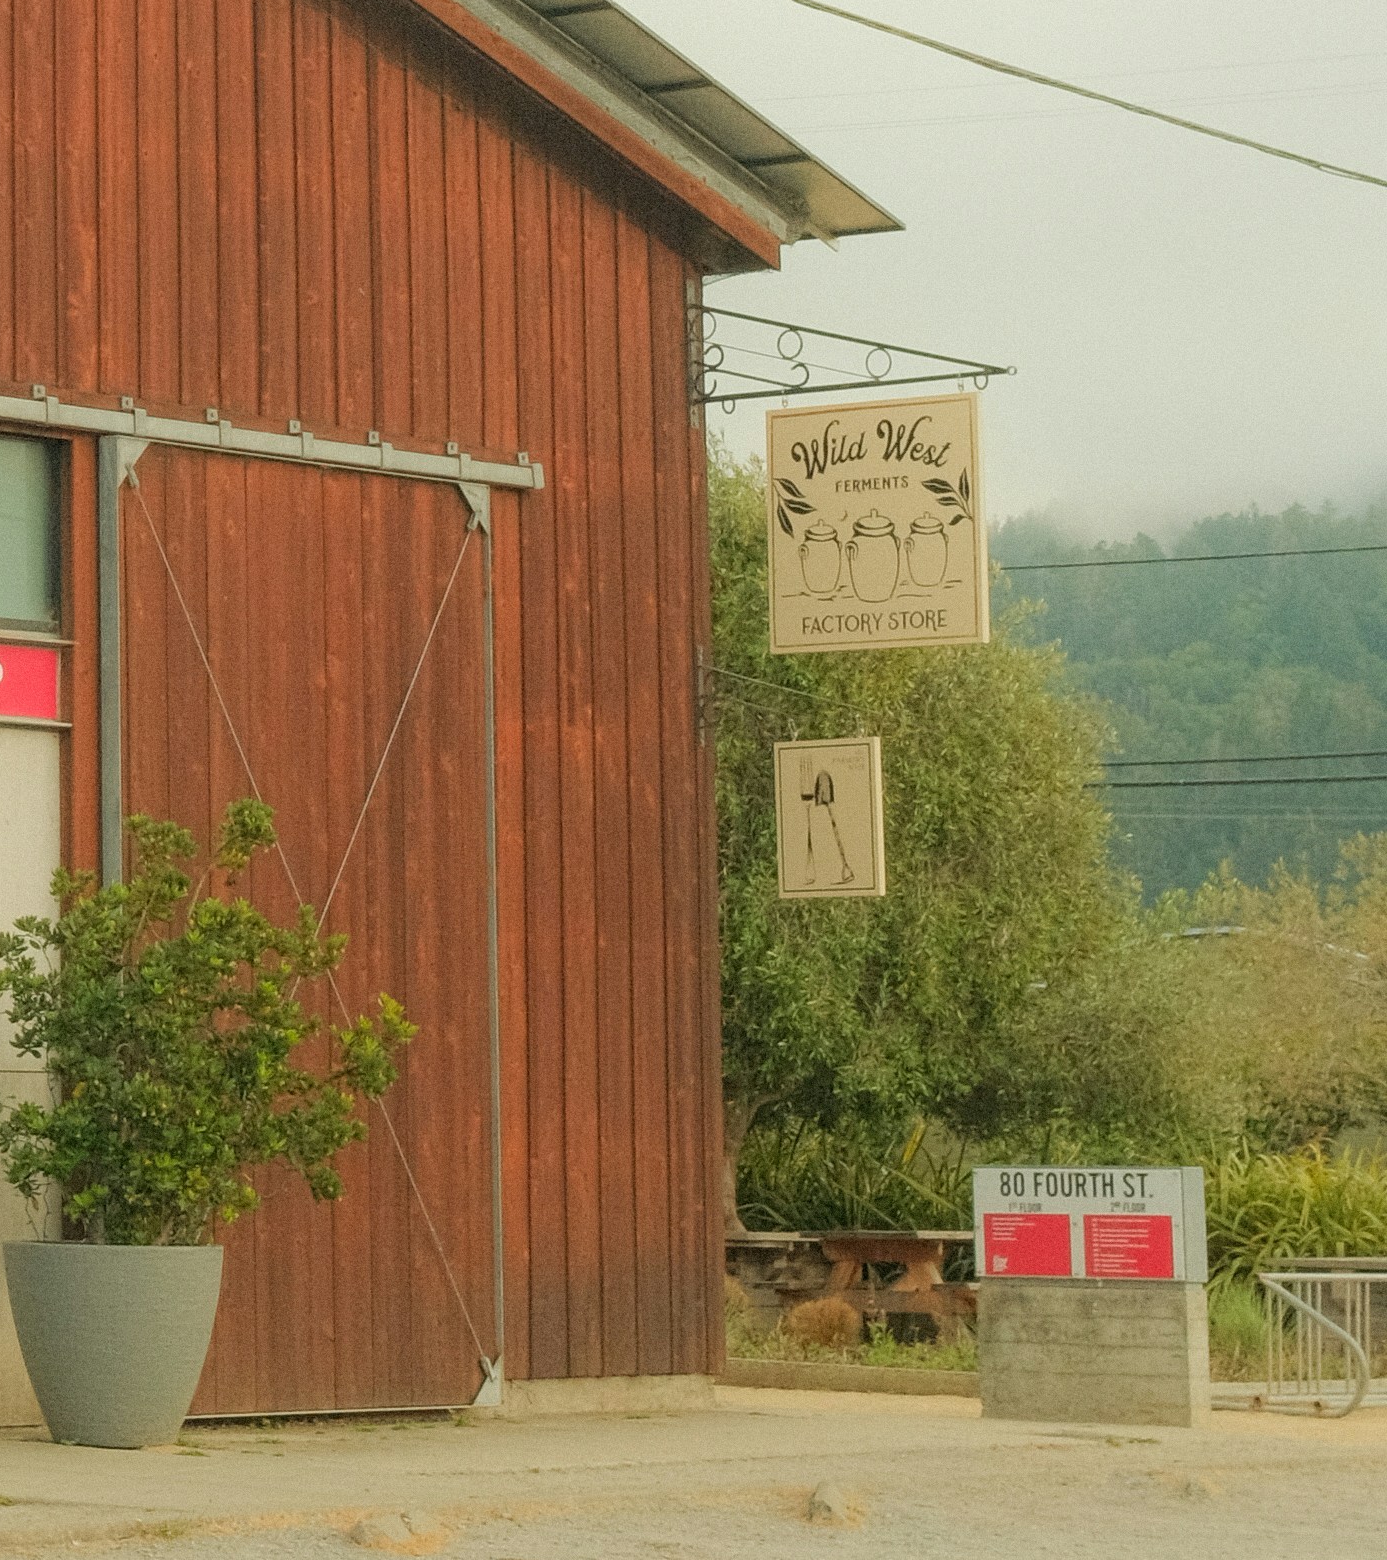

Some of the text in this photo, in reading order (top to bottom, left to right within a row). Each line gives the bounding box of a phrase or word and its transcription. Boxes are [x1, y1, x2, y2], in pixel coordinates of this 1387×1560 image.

[791, 415, 951, 479] Wild West
[835, 476, 909, 493] FERMENTS
[802, 609, 947, 635] FACTORY STORE
[1000, 1172, 1154, 1198] 80 FOURTH ST.
